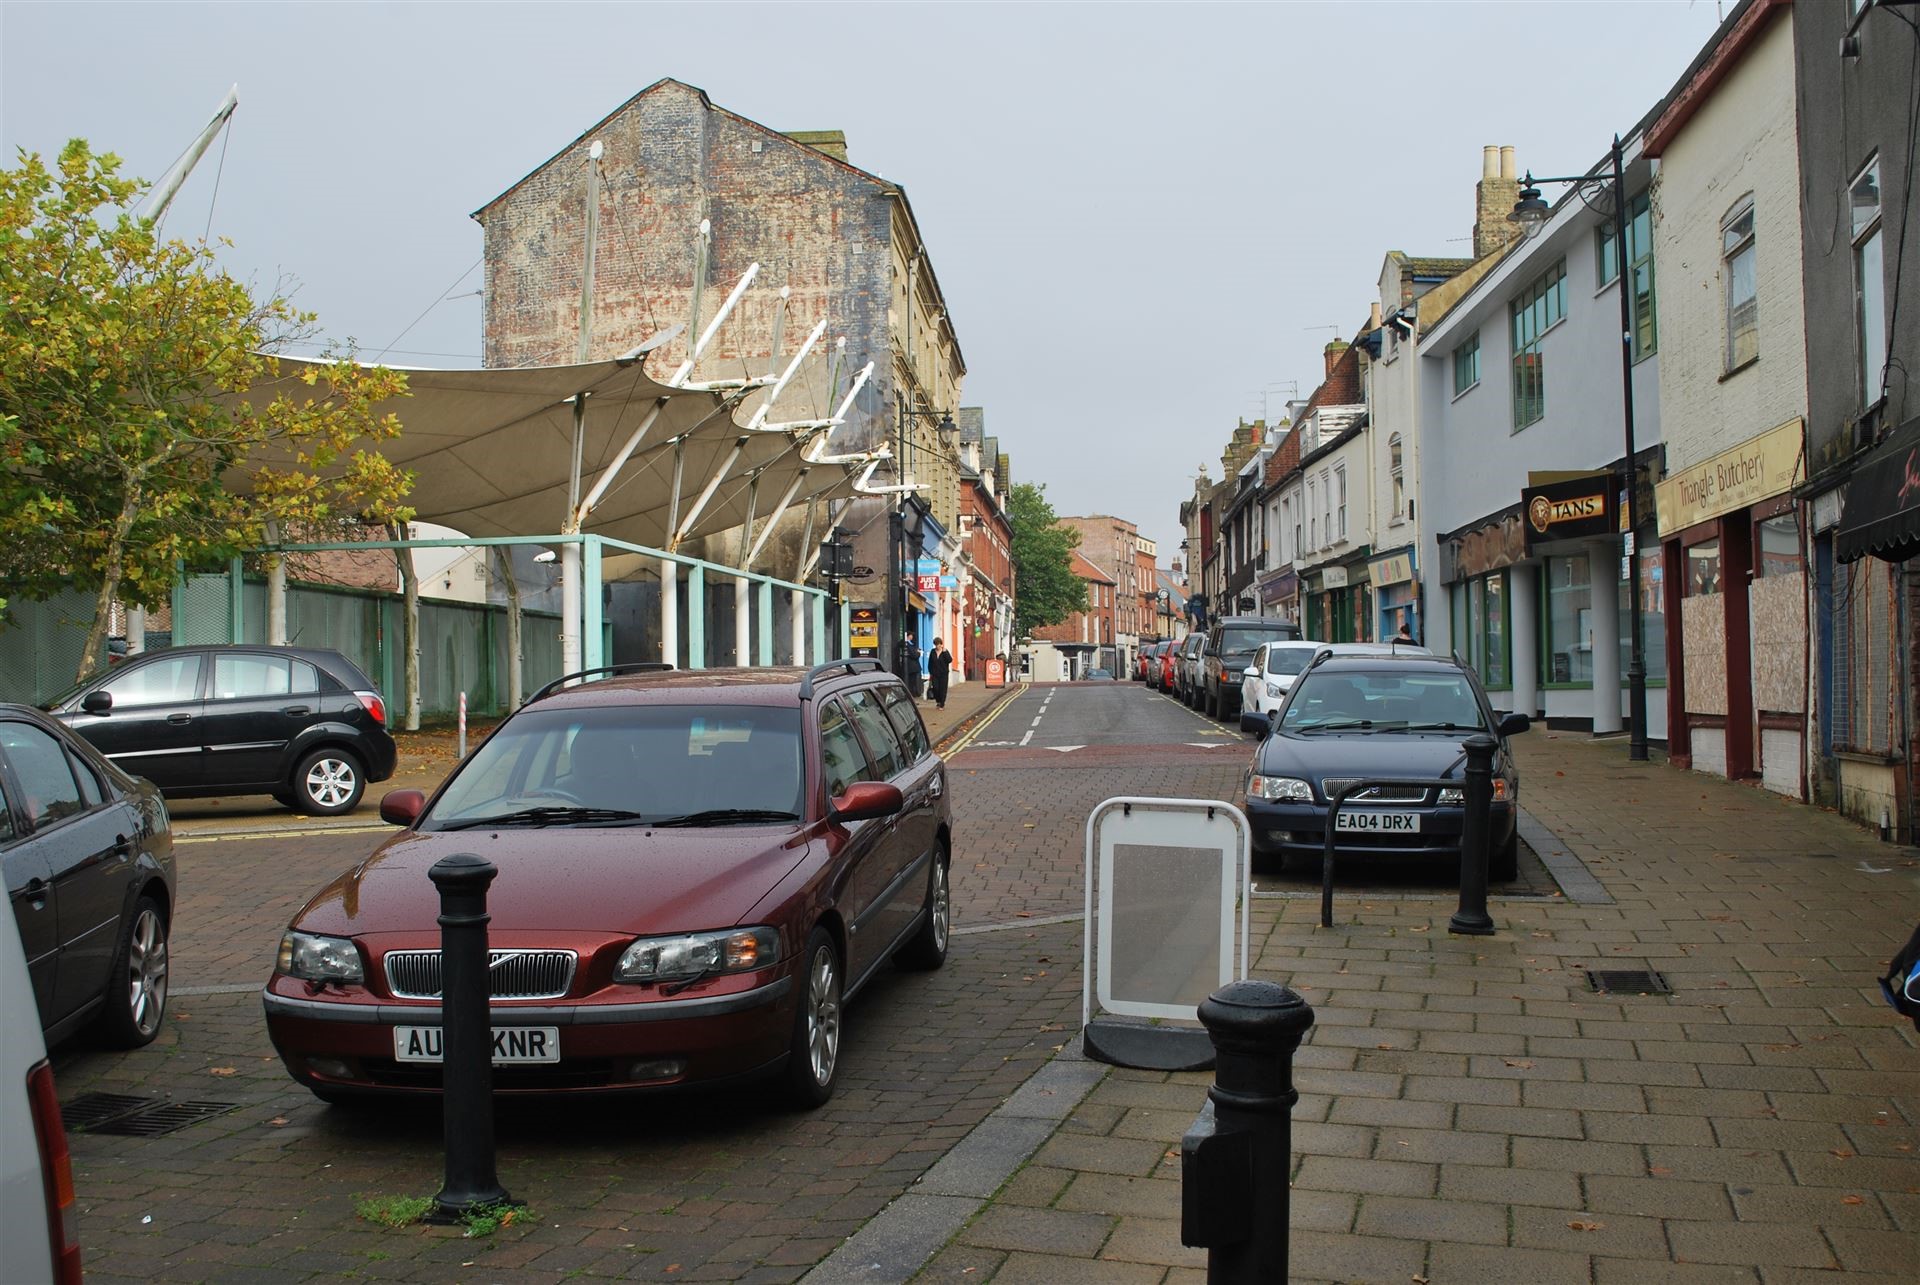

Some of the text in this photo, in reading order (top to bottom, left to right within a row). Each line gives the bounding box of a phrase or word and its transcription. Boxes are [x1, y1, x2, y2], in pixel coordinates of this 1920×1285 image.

[1679, 469, 1714, 509] Triangle
[1717, 452, 1765, 492] Butchery
[1553, 498, 1595, 519] TANS
[920, 576, 937, 584] JUST
[1337, 814, 1413, 830] EA04 DRX
[408, 1029, 546, 1058] AU KNR
